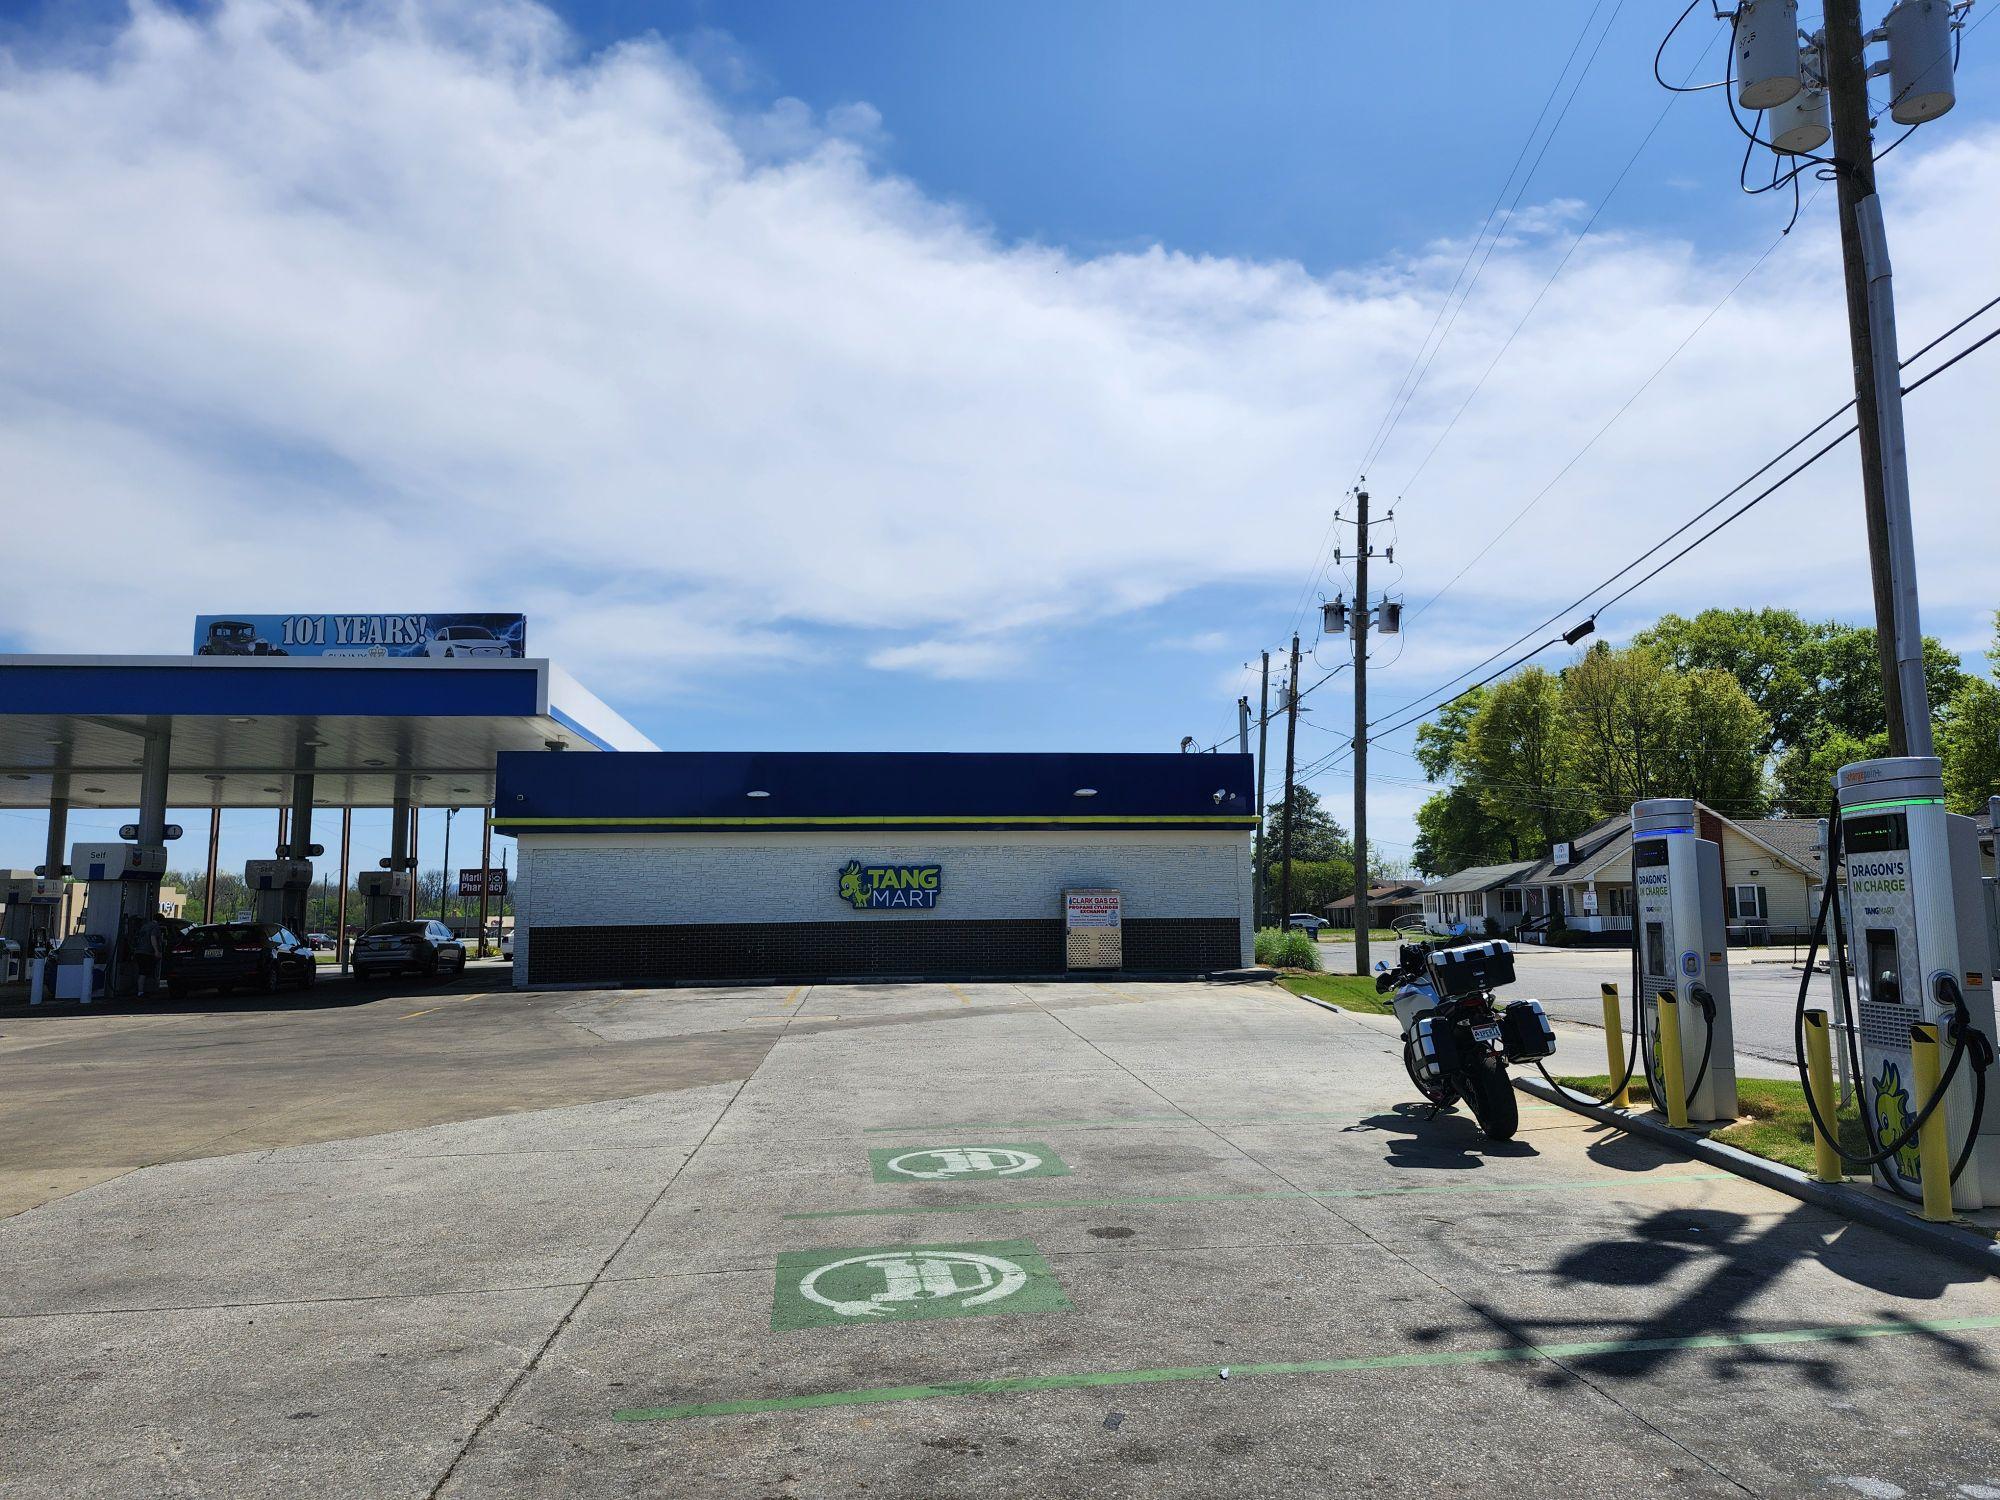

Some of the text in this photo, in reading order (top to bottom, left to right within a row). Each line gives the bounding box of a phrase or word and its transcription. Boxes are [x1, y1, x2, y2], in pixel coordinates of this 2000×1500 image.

[283, 616, 427, 645] 101 YEARS!
[90, 851, 106, 859] Self
[1851, 862, 1904, 877] DRAGON'S
[461, 873, 492, 882] Martis
[867, 868, 939, 889] TANG
[1639, 874, 1667, 885] DRAGON'S
[461, 883, 503, 893] Pharacy
[1646, 887, 1668, 896] CHARGE
[1853, 880, 1905, 894] IN CHARGE
[873, 890, 938, 907] MART
